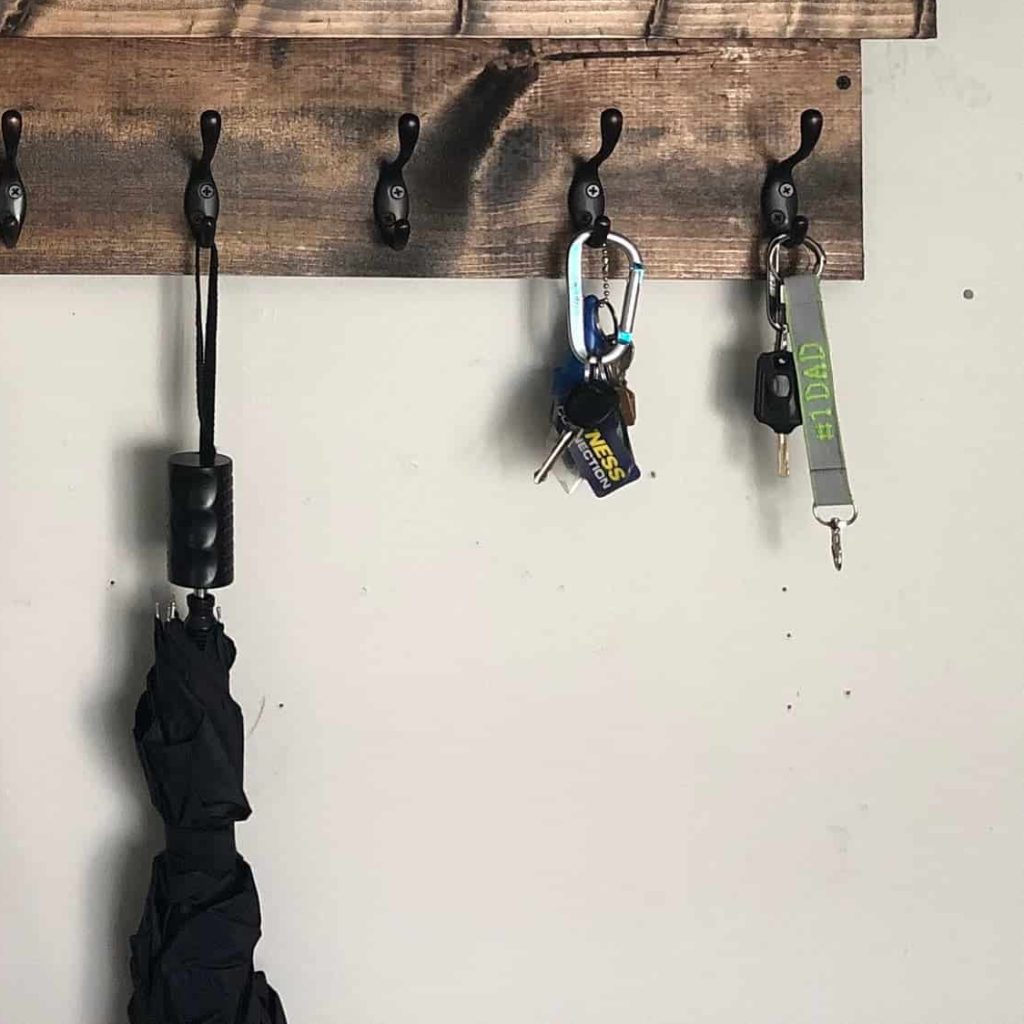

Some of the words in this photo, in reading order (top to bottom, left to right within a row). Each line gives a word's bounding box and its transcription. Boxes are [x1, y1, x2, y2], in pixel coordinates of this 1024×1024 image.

[798, 342, 831, 401] DAD
[811, 408, 835, 440] #1
[584, 428, 627, 482] NESS
